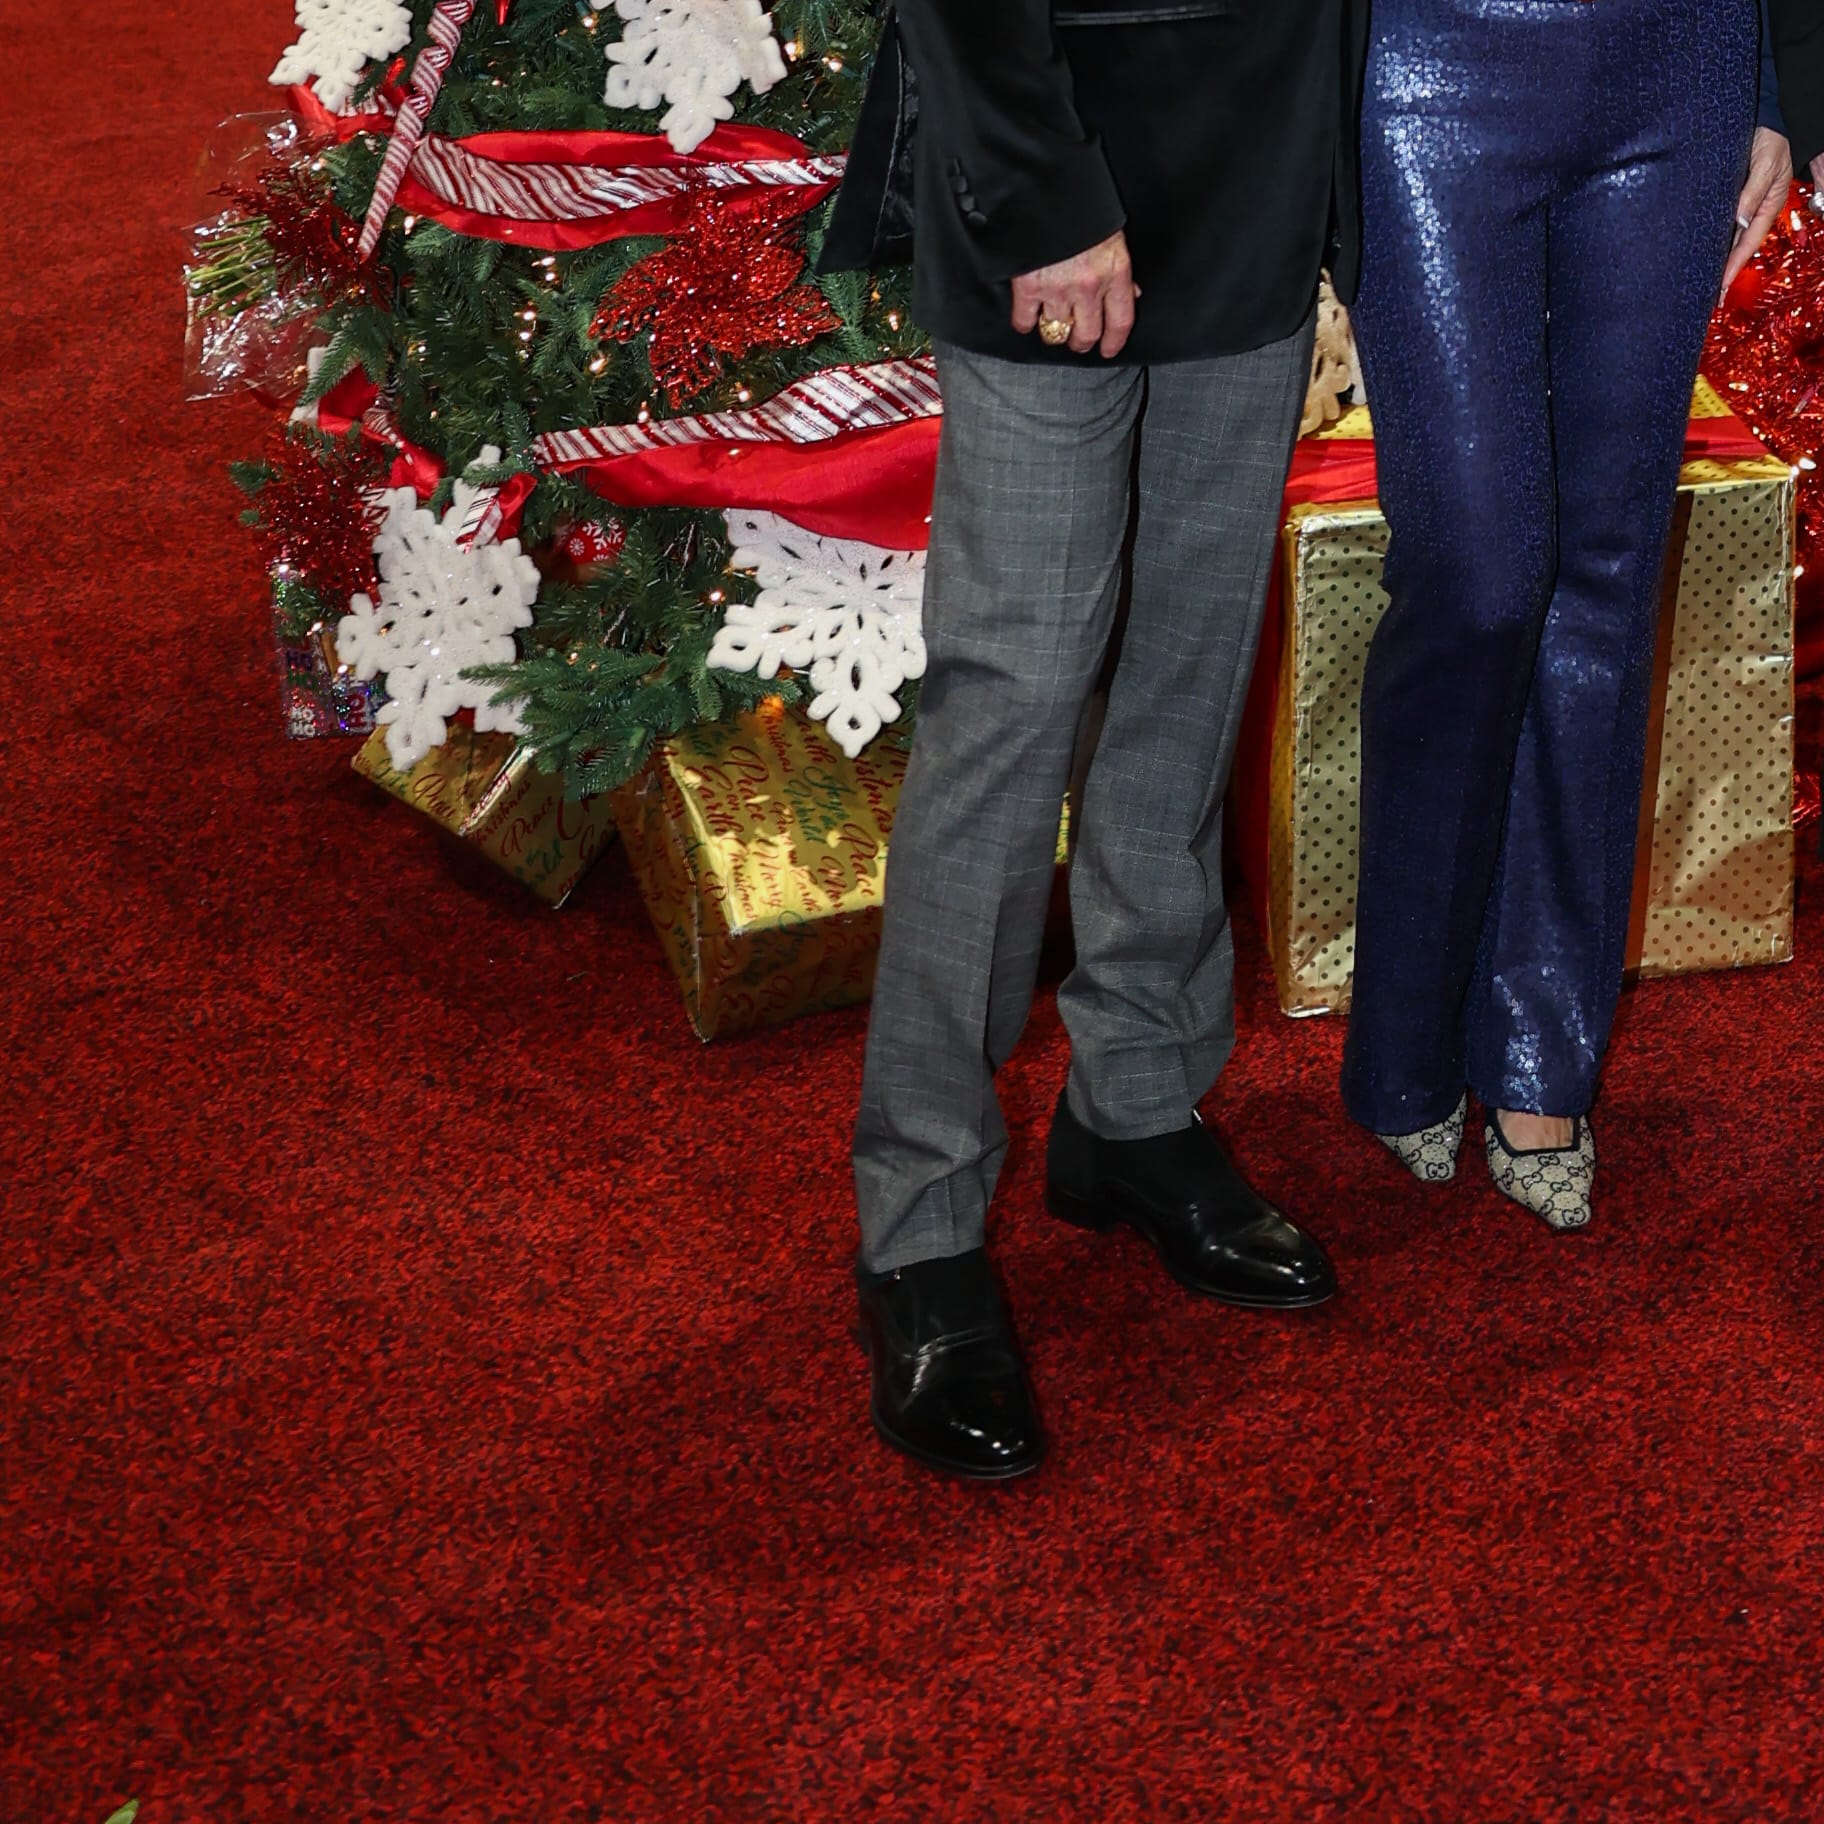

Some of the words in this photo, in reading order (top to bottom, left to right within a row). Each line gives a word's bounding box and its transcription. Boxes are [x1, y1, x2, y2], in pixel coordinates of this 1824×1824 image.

[685, 764, 744, 834] Earth
[723, 746, 770, 822] Peace
[839, 823, 878, 897] Peace
